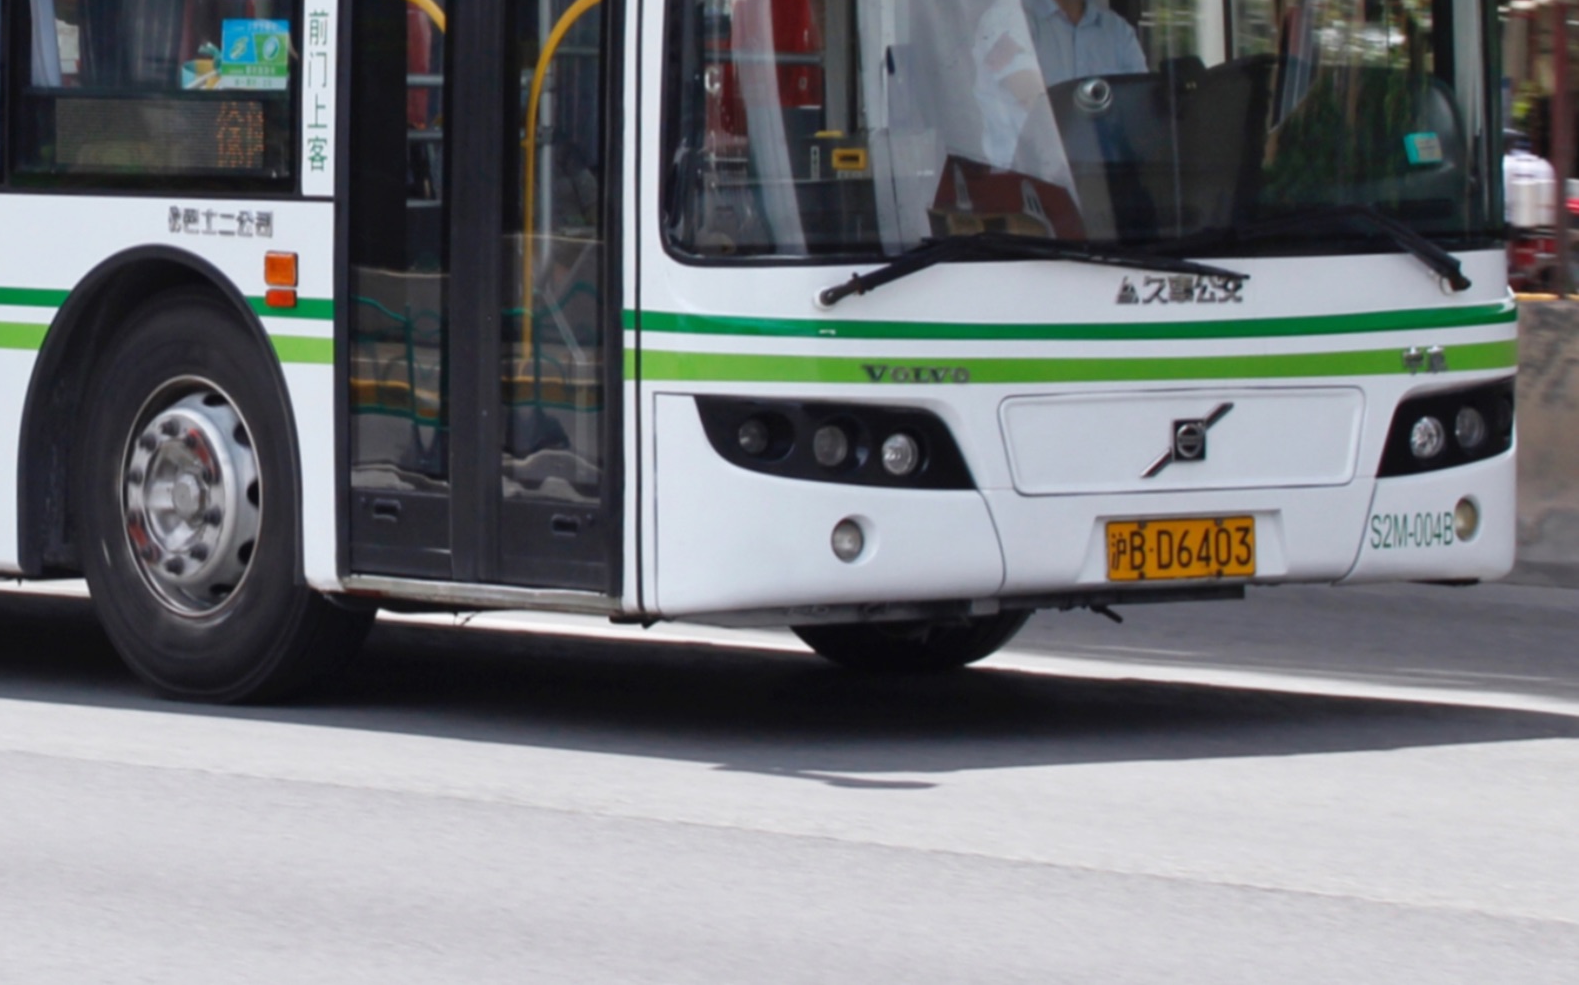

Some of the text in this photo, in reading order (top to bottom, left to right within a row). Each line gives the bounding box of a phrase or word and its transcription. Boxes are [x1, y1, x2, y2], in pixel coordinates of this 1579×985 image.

[307, 9, 329, 171] 前门上客
[860, 364, 971, 385] VOLVO
[1111, 525, 1253, 570] 沪B·D6403
[1370, 512, 1454, 549] S2M-004B
